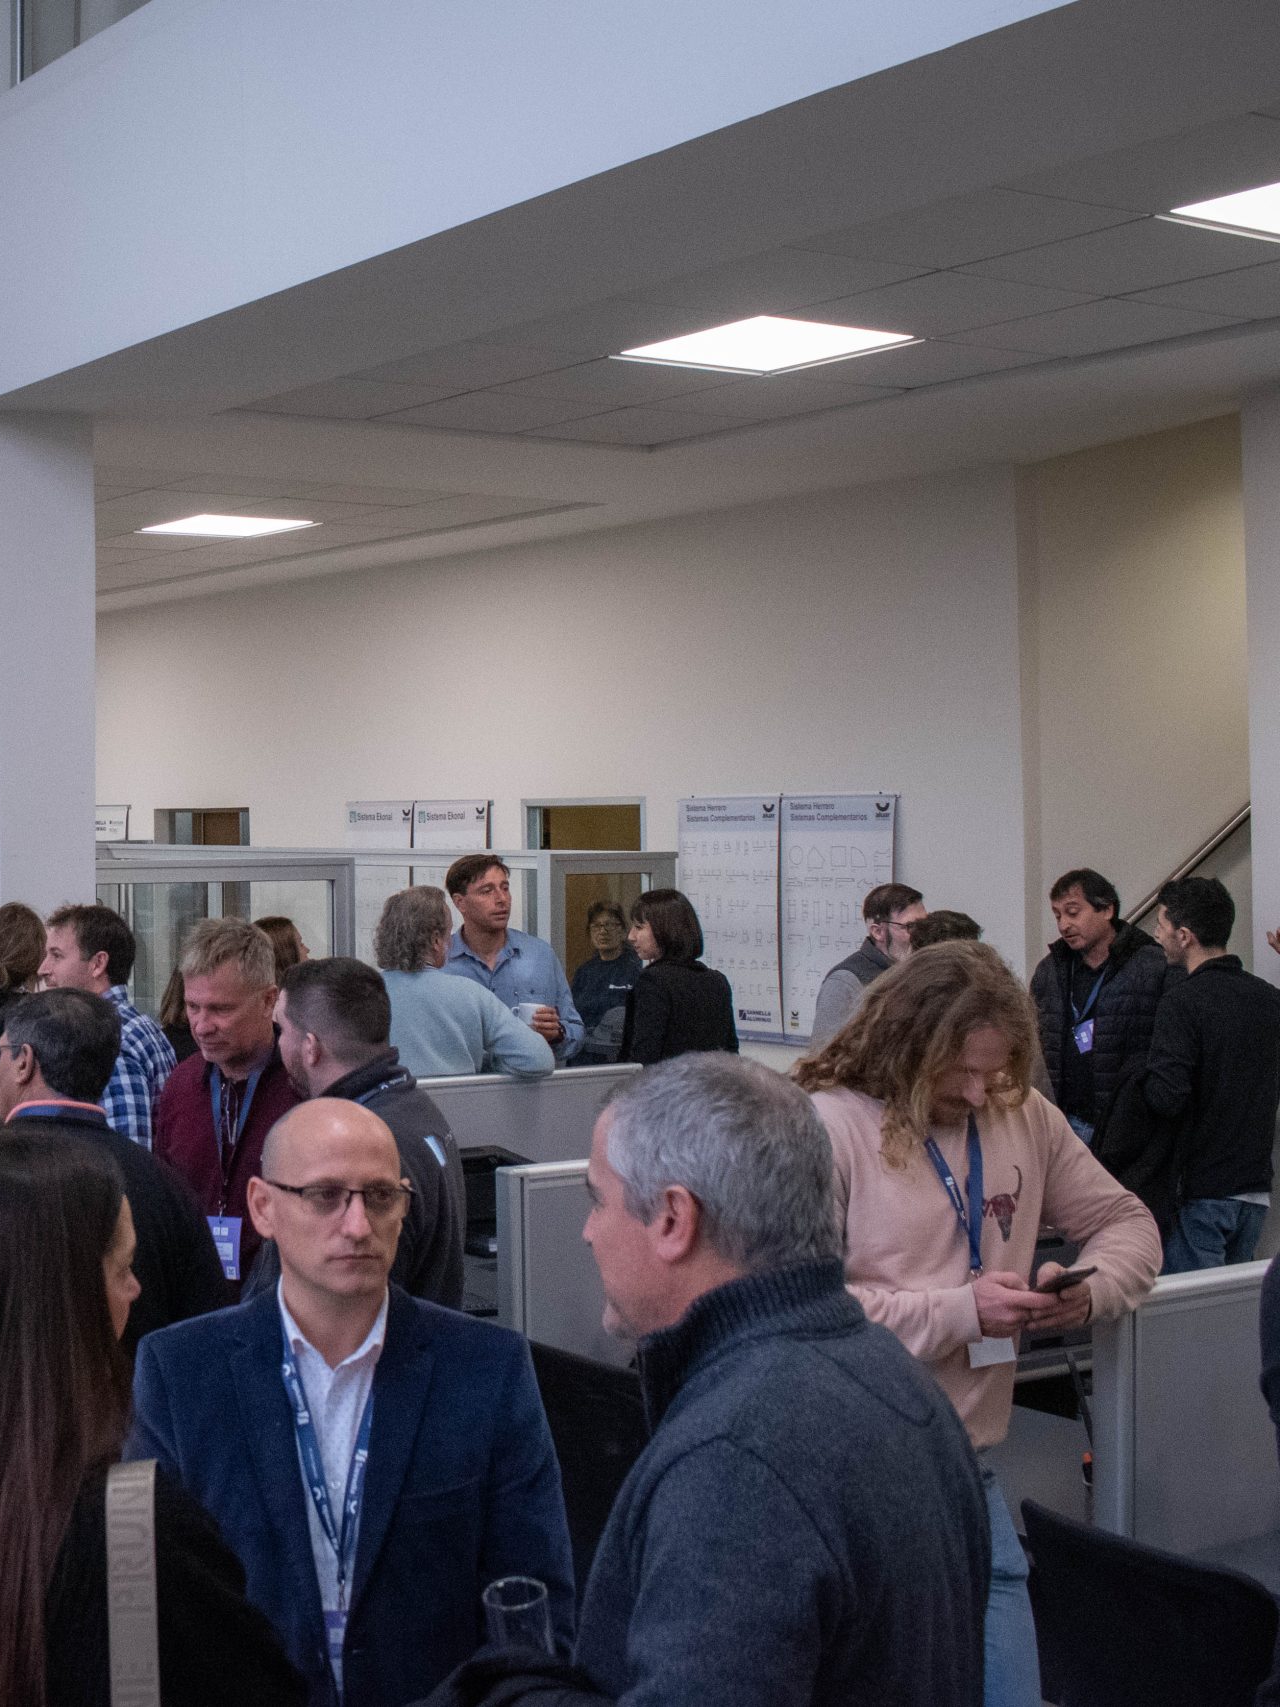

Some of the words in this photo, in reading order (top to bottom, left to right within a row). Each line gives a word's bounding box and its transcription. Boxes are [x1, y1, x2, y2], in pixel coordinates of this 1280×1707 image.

[357, 812, 376, 821] Sistema
[376, 812, 393, 821] Ekonal
[426, 812, 446, 821] Sistema
[448, 811, 465, 820] Ekonal
[710, 814, 756, 823] Complementarios
[816, 813, 868, 822] Complementarios
